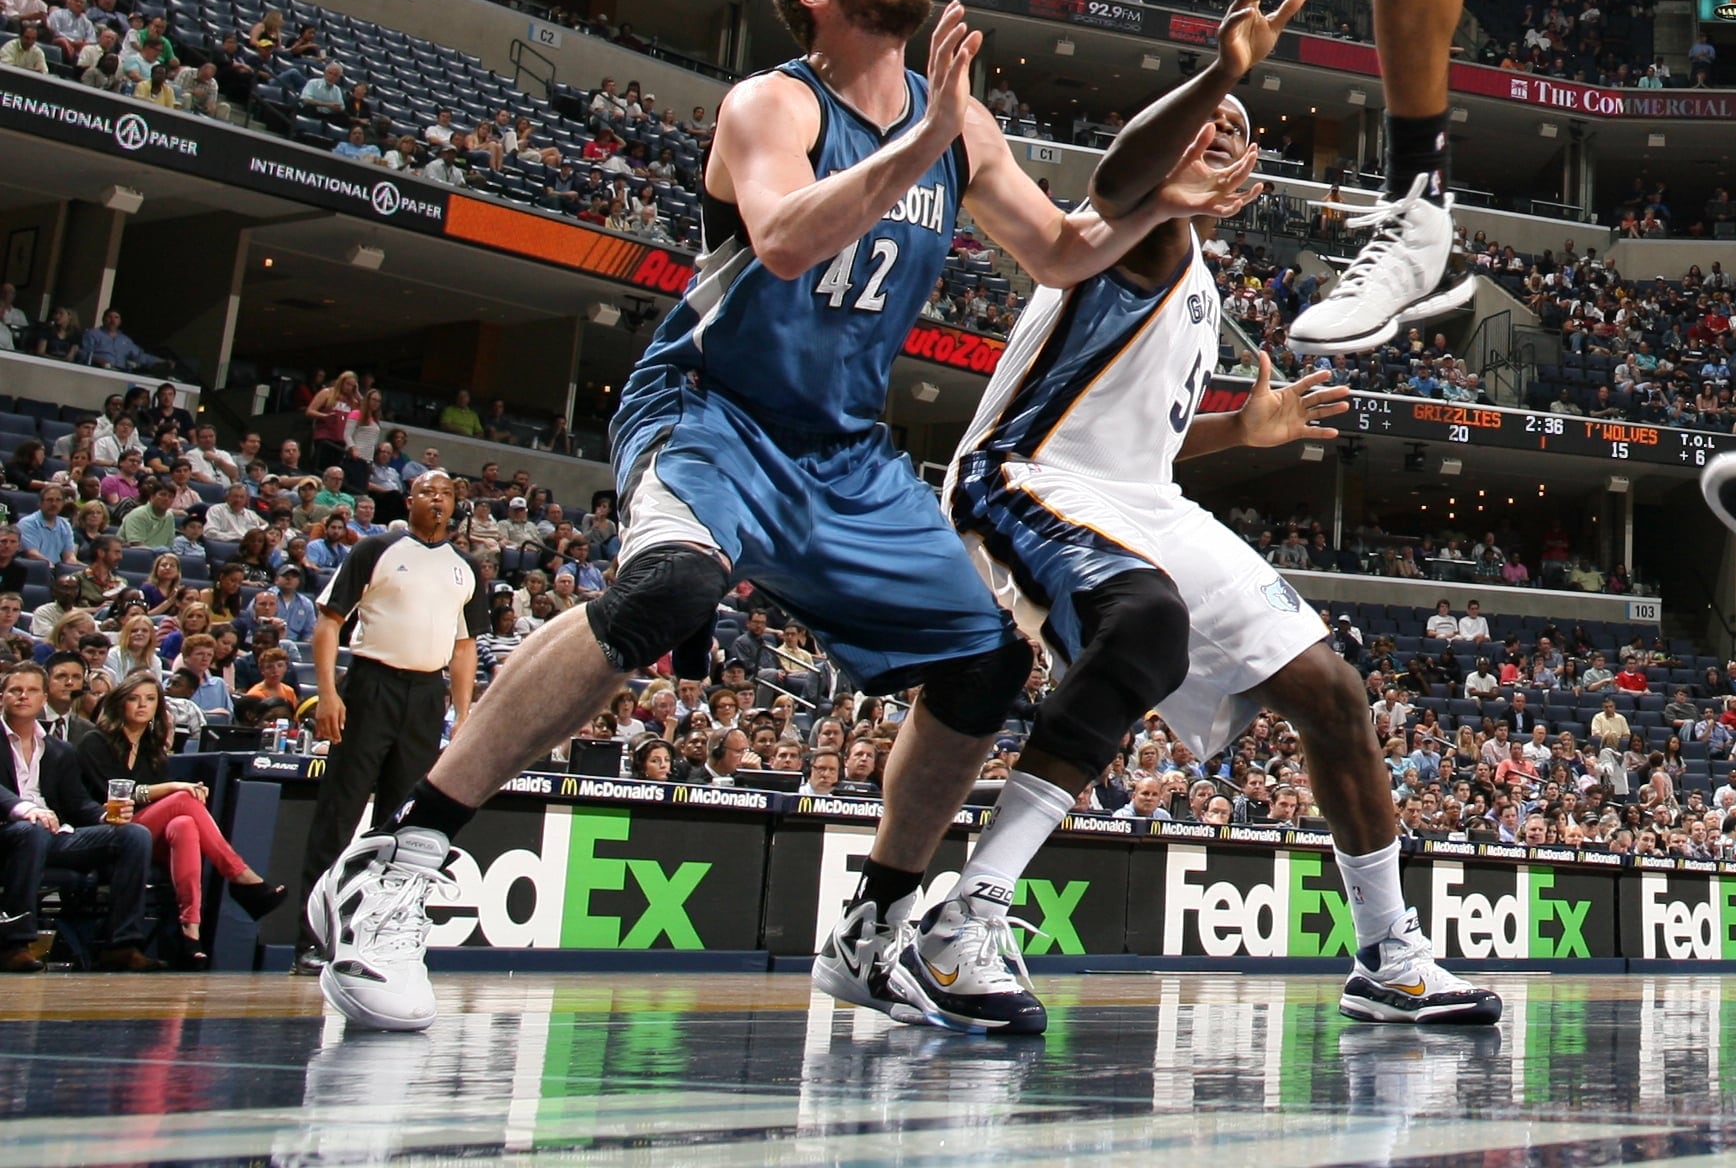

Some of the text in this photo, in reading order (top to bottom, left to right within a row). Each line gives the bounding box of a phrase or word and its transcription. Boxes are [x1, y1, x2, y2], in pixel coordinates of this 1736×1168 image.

[1088, 0, 1142, 22] 92.9FM
[540, 30, 554, 44] C2
[1535, 80, 1578, 109] THE
[1583, 90, 1732, 117] COMMERCIAL
[0, 90, 198, 156] ERNATIONAL PAPER
[1040, 148, 1053, 161] C1
[250, 157, 443, 220] INTERNATIONAL PAPER
[815, 238, 898, 312] 42
[903, 327, 1003, 377] utoZon
[1352, 398, 1392, 413] T.O.L
[1414, 403, 1502, 428] GRIZZLIES
[1359, 414, 1370, 430] 5
[1526, 415, 1564, 436] 2:36
[1449, 425, 1469, 443] 20
[1584, 422, 1658, 445] T'WOLVES
[1681, 433, 1715, 449] T.O.L
[1611, 442, 1629, 460] 15
[1695, 450, 1705, 465] 6
[1635, 604, 1655, 618] 103
[501, 777, 884, 818] nald's McDonald's McDonald's McDonald's
[1074, 817, 1332, 846] McDonald's McDonald's McDonald's McDonal
[1433, 844, 1475, 855] McDonald's
[1487, 847, 1526, 858] McDonald's
[1537, 850, 1575, 861] McDonald's
[1585, 852, 1620, 864] McDonald's
[427, 805, 712, 950] edEx
[1163, 844, 1353, 958] FedEx
[1432, 860, 1592, 959] FedEx
